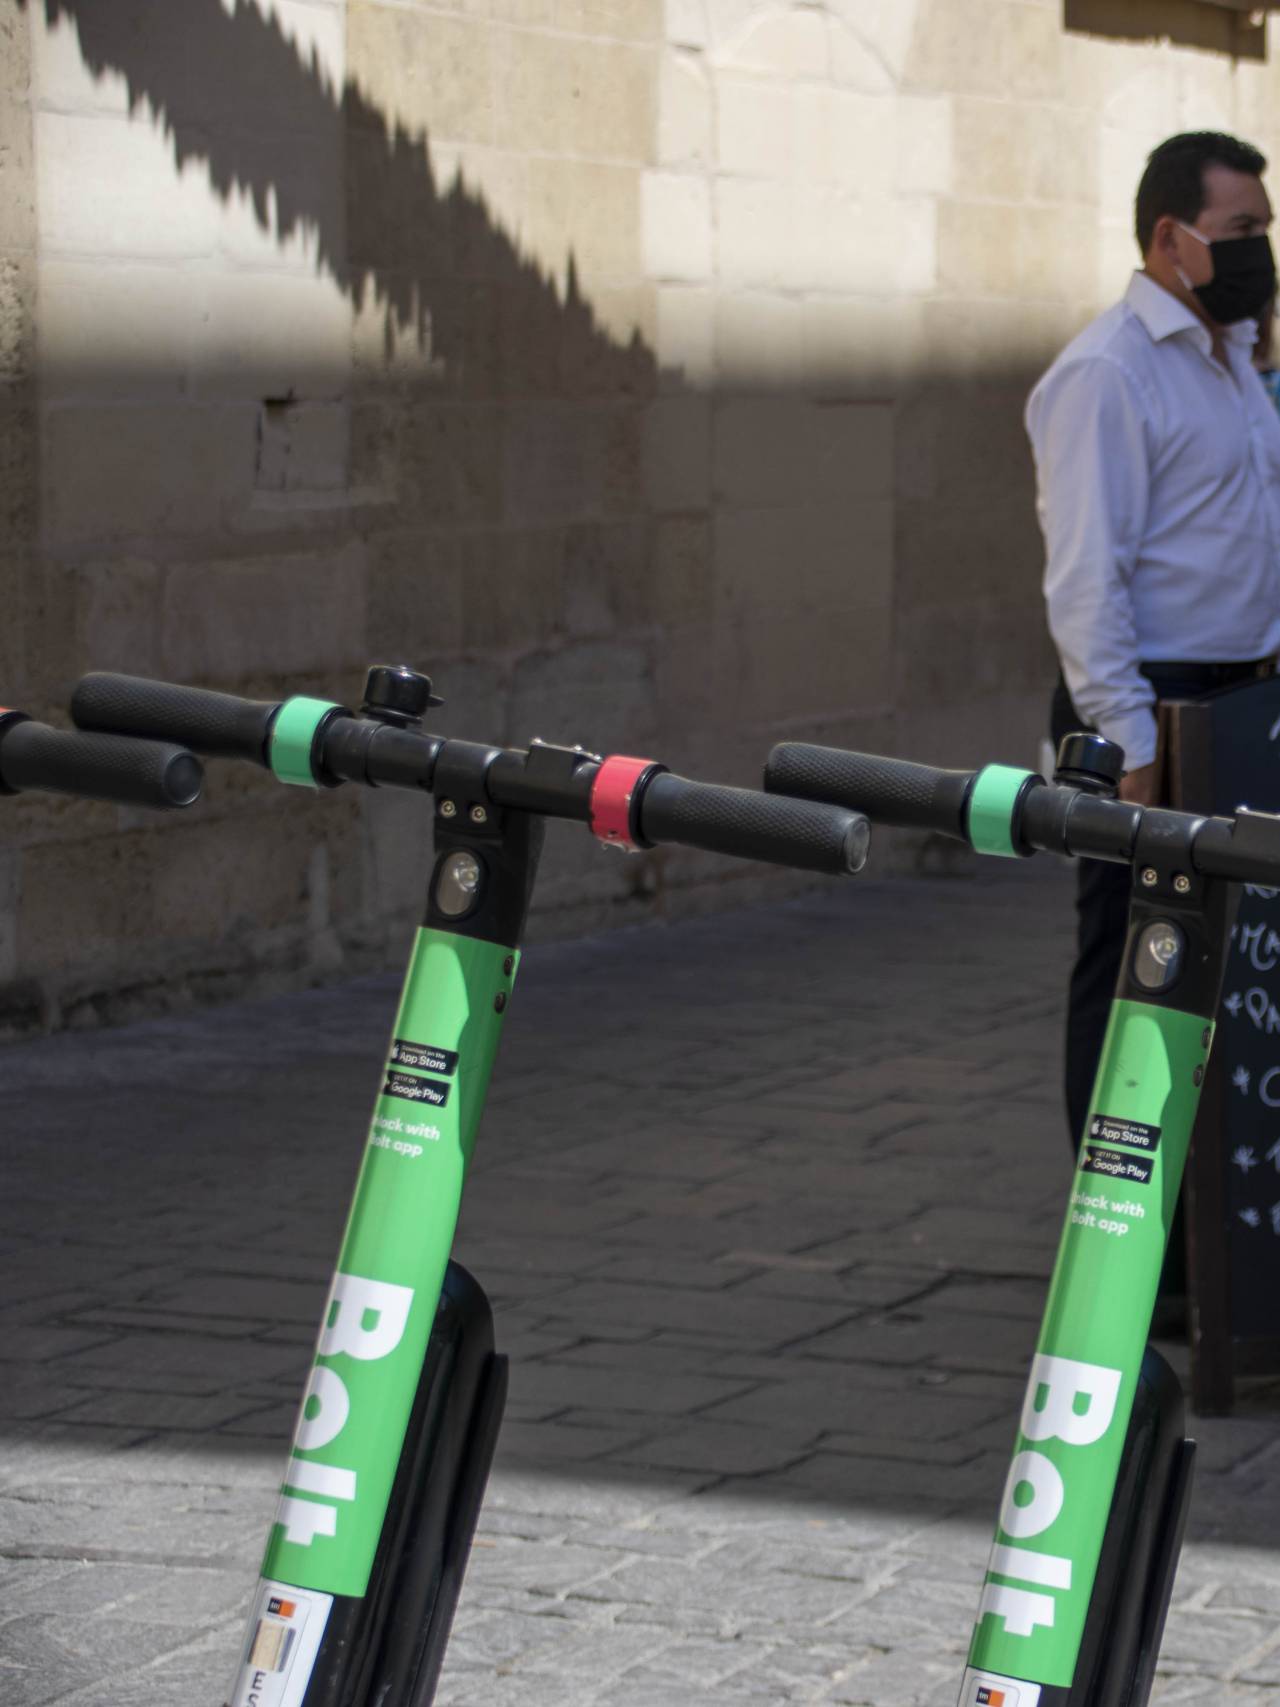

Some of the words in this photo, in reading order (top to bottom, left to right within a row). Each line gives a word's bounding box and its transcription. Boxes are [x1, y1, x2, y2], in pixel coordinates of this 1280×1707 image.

[399, 1052, 418, 1065] App
[418, 1055, 447, 1070] Store
[391, 1081, 422, 1098] Google
[423, 1088, 444, 1103] Play
[405, 1123, 440, 1142] with
[1101, 1127, 1120, 1140] App
[1121, 1130, 1150, 1145] Store
[393, 1141, 423, 1158] app
[1093, 1158, 1126, 1174] Google
[1127, 1164, 1148, 1181] Play
[1111, 1200, 1145, 1219] with
[1098, 1219, 1129, 1237] app
[277, 1273, 415, 1546] Bolt
[977, 1352, 1123, 1637] Bolt
